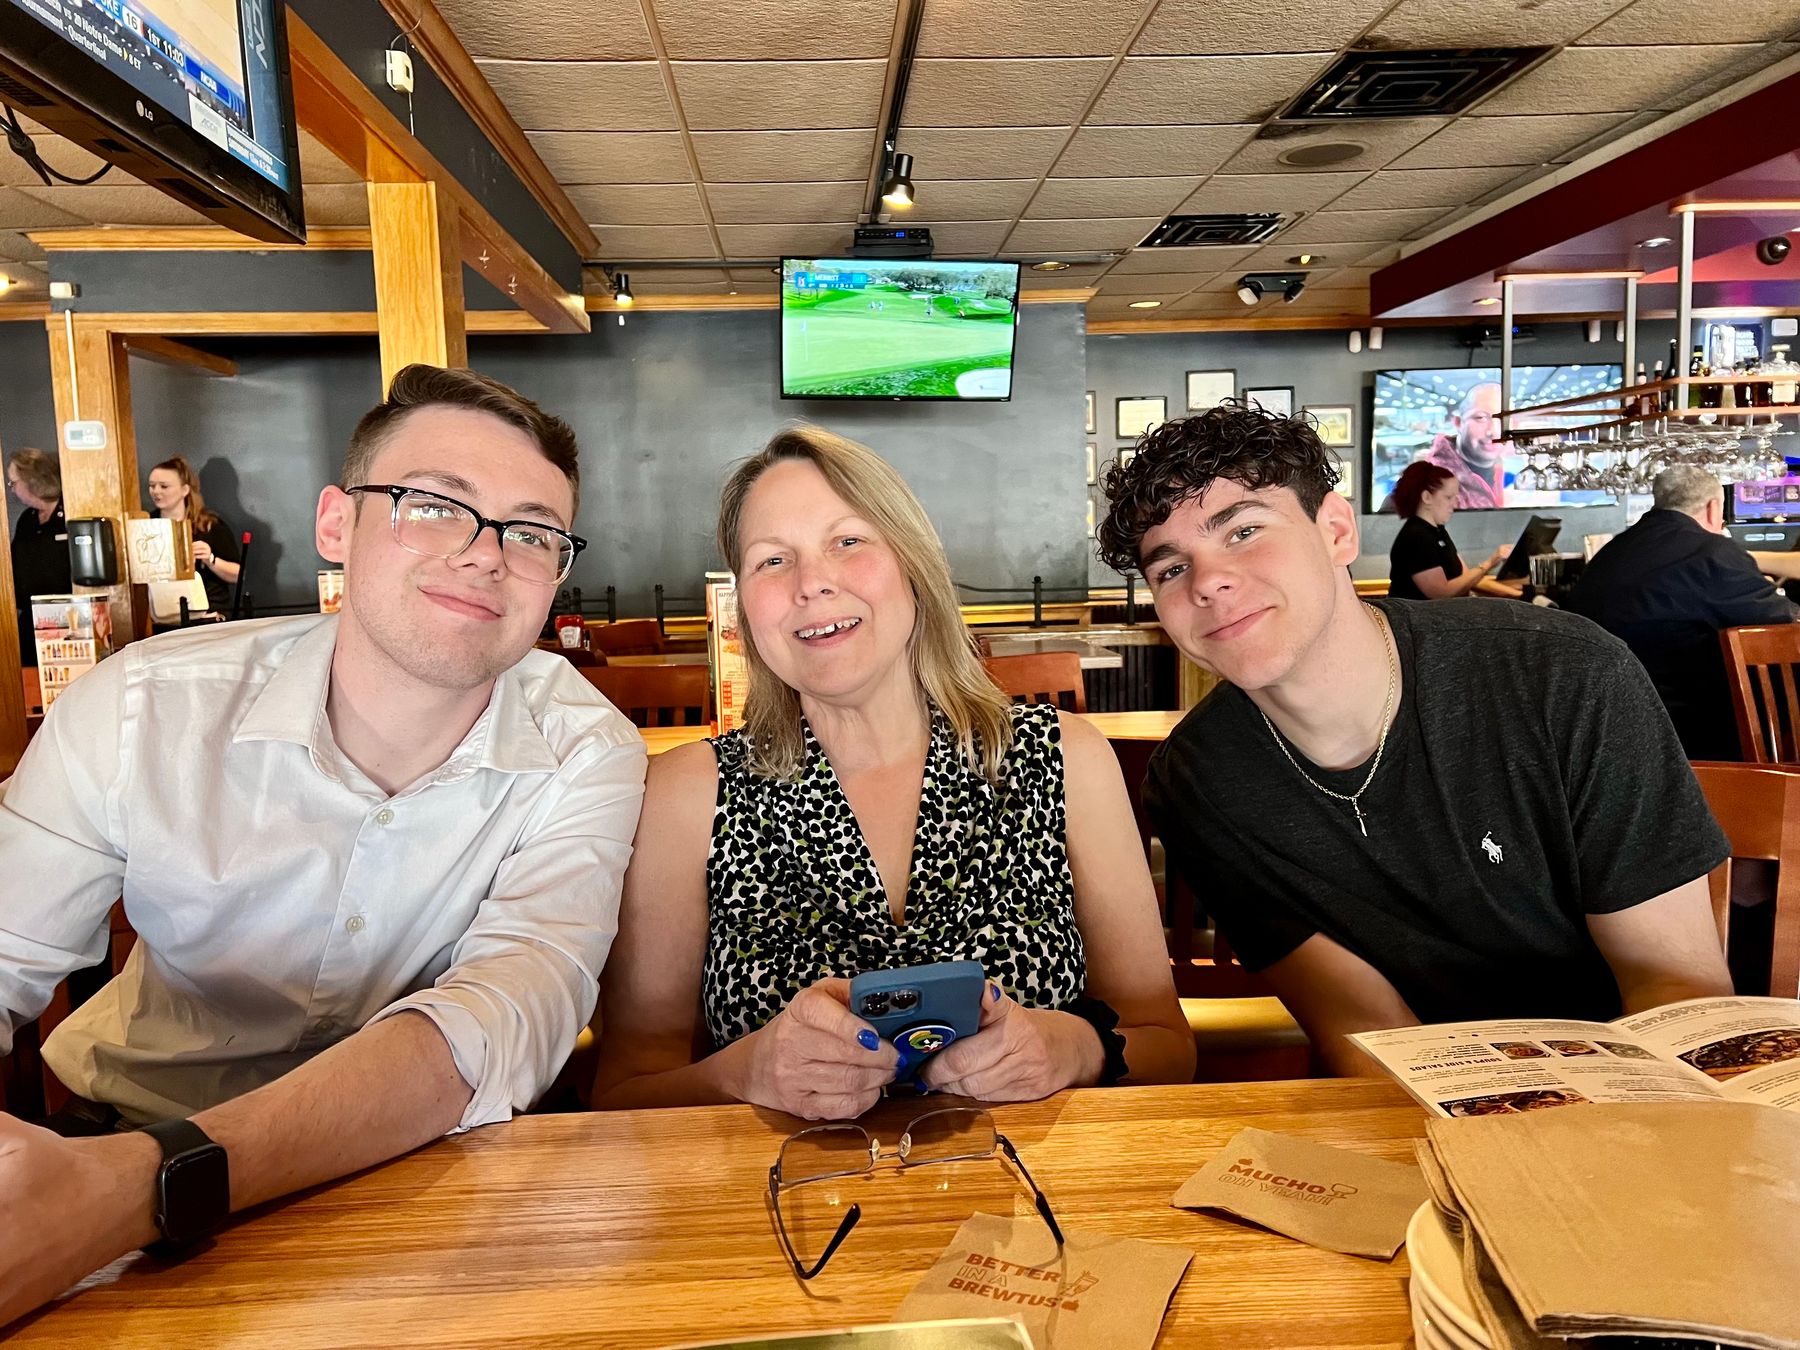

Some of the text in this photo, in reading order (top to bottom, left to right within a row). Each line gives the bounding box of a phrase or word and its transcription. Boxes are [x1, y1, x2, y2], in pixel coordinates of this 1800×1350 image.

[100, 0, 120, 16] UKE
[126, 12, 138, 30] 16
[82, 18, 102, 43] Notre
[103, 33, 122, 57] Dame
[145, 109, 154, 122] LG
[1409, 1063, 1443, 1071] SALADS
[1228, 1164, 1326, 1194] MUCHO
[956, 1265, 1007, 1287] IN A
[966, 1253, 1062, 1283] BETTER
[948, 1277, 1058, 1308] BREWTUS
